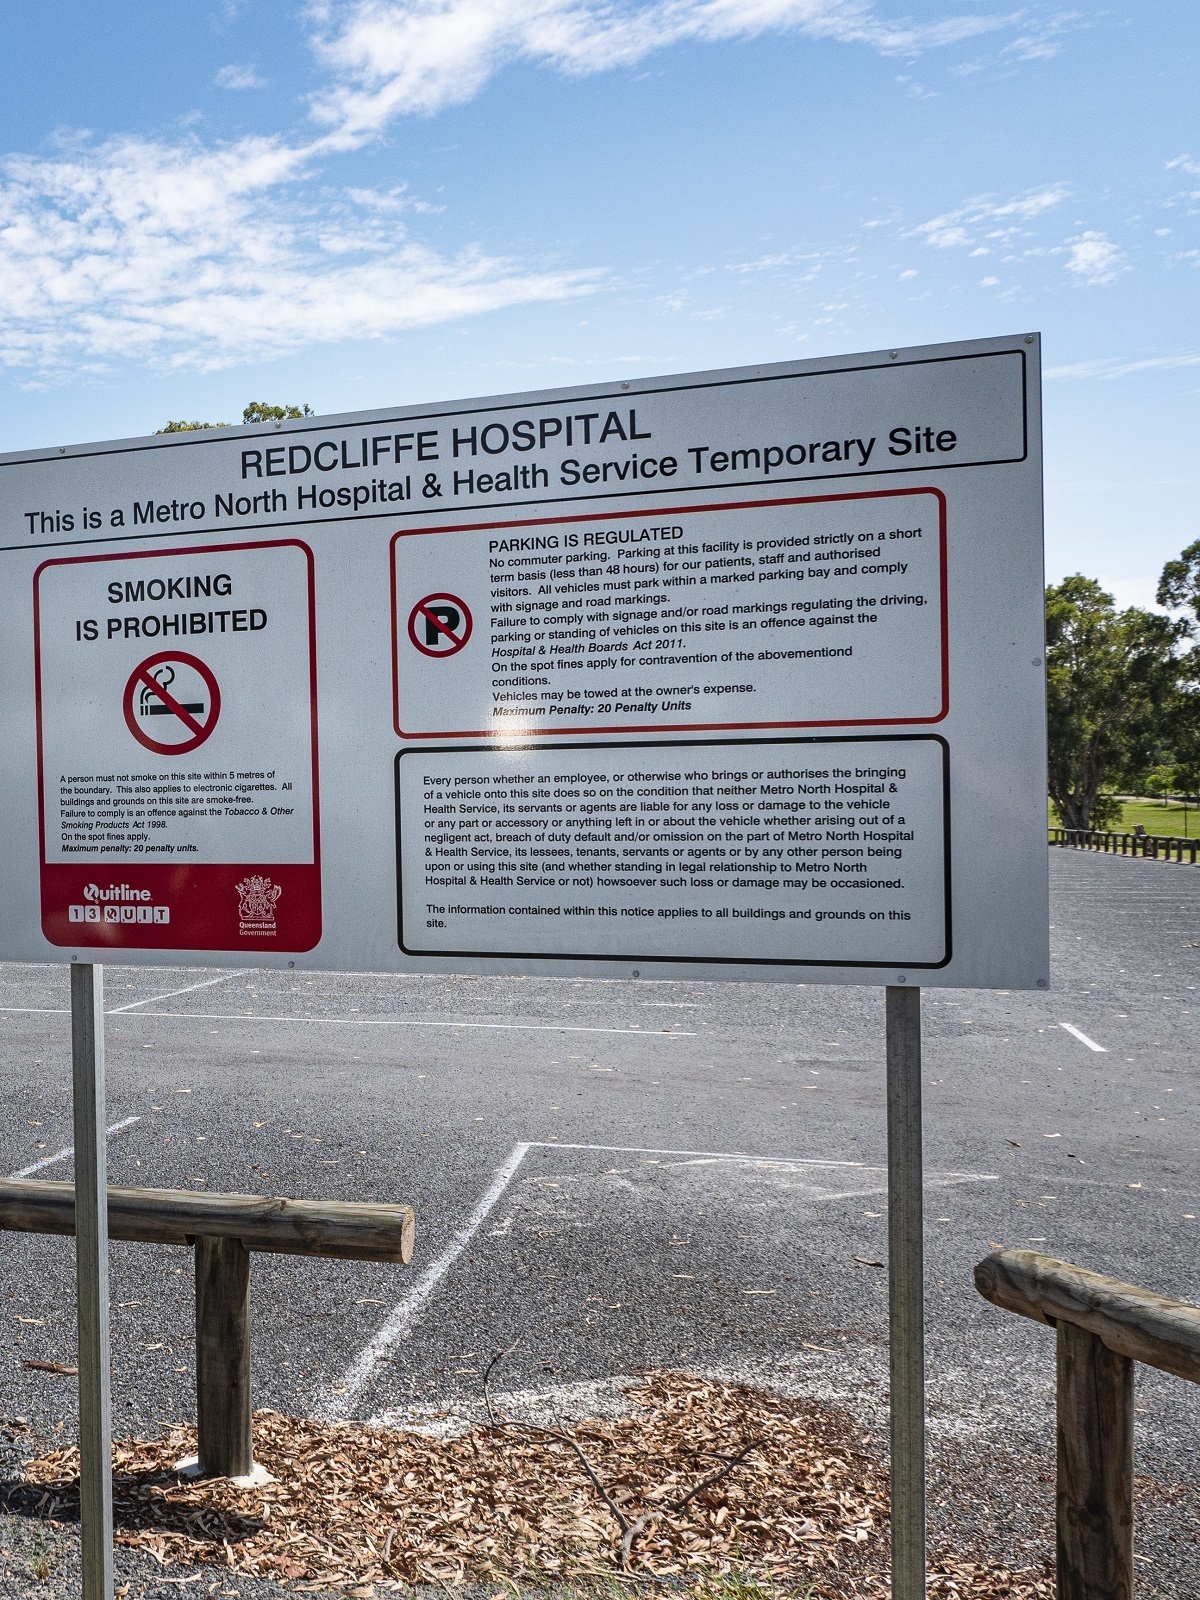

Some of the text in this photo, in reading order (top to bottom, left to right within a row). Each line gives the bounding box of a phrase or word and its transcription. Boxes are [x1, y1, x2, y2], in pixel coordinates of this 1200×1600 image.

[241, 409, 651, 480] REDCLIFFE HOSPITAL
[24, 426, 958, 535] This is a Metro North Hospital & Health Service Temporary Site
[489, 526, 684, 554] PARKING IS REGULATED
[489, 527, 923, 569] No commuter parking. Parking at this facility is provided strictly on a short
[490, 546, 881, 584] term basis (less than 48 hours) for our patients, staff and authorised
[108, 574, 233, 605] SMOKING
[490, 561, 909, 599] visitors. All vehicles must park within a marked parking bay and comply
[490, 594, 671, 614] with signage and road markings.
[76, 609, 268, 642] IS PROHIBITED
[491, 638, 687, 660] Hospital & Health Boards Act 2011.
[491, 646, 853, 673] On the spot fines apply for contravention of the abovementiond
[492, 676, 552, 688] conditions.
[492, 684, 757, 703] Vehicles may be towed at the owner's expense.
[493, 700, 693, 717] Maximum Penalty: 20 Penalty Units
[60, 770, 276, 785] A person must not smoke on this site within 5 metres of
[423, 767, 907, 788] Every person whether an employee, or otherwise who brings or authorises the bringing
[60, 795, 255, 809] buildings and grounds on this site are smoke-free.
[61, 844, 200, 855] Maximum penalty: 20 penalty units.
[83, 883, 151, 902] Quitline
[425, 875, 905, 891] Hospital & Health Service or not) howsoever such loss or damage may be occasioned.
[239, 921, 276, 929] Queensland
[239, 929, 277, 937] Government
[426, 918, 448, 929] site.
